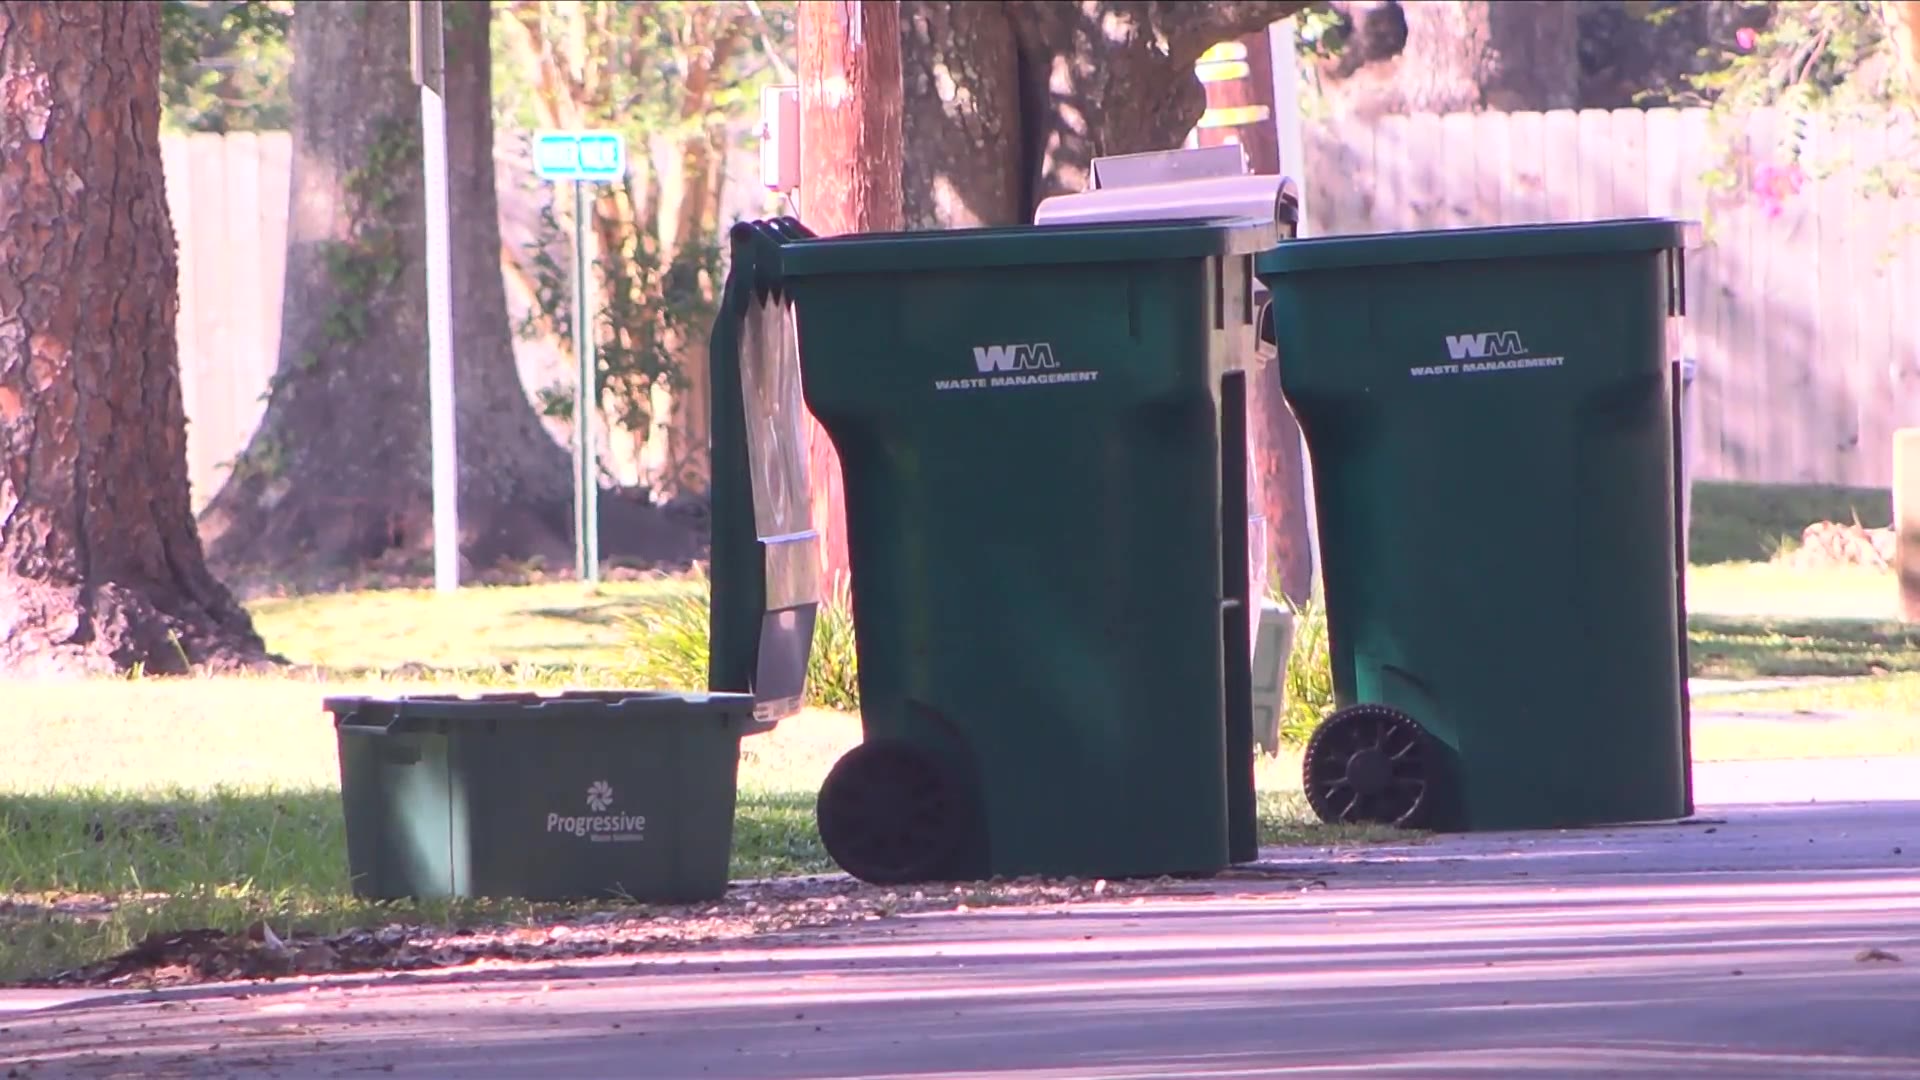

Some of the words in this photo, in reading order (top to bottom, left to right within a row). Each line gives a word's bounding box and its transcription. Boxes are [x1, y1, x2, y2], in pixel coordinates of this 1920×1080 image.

[973, 343, 1055, 372] WM
[1446, 331, 1523, 359] WM
[1410, 364, 1459, 376] WASTE
[1463, 357, 1565, 372] MANAGEMENT
[935, 378, 986, 390] WASTE
[991, 371, 1098, 387] MANAGEMENT
[547, 811, 646, 836] Progressive
